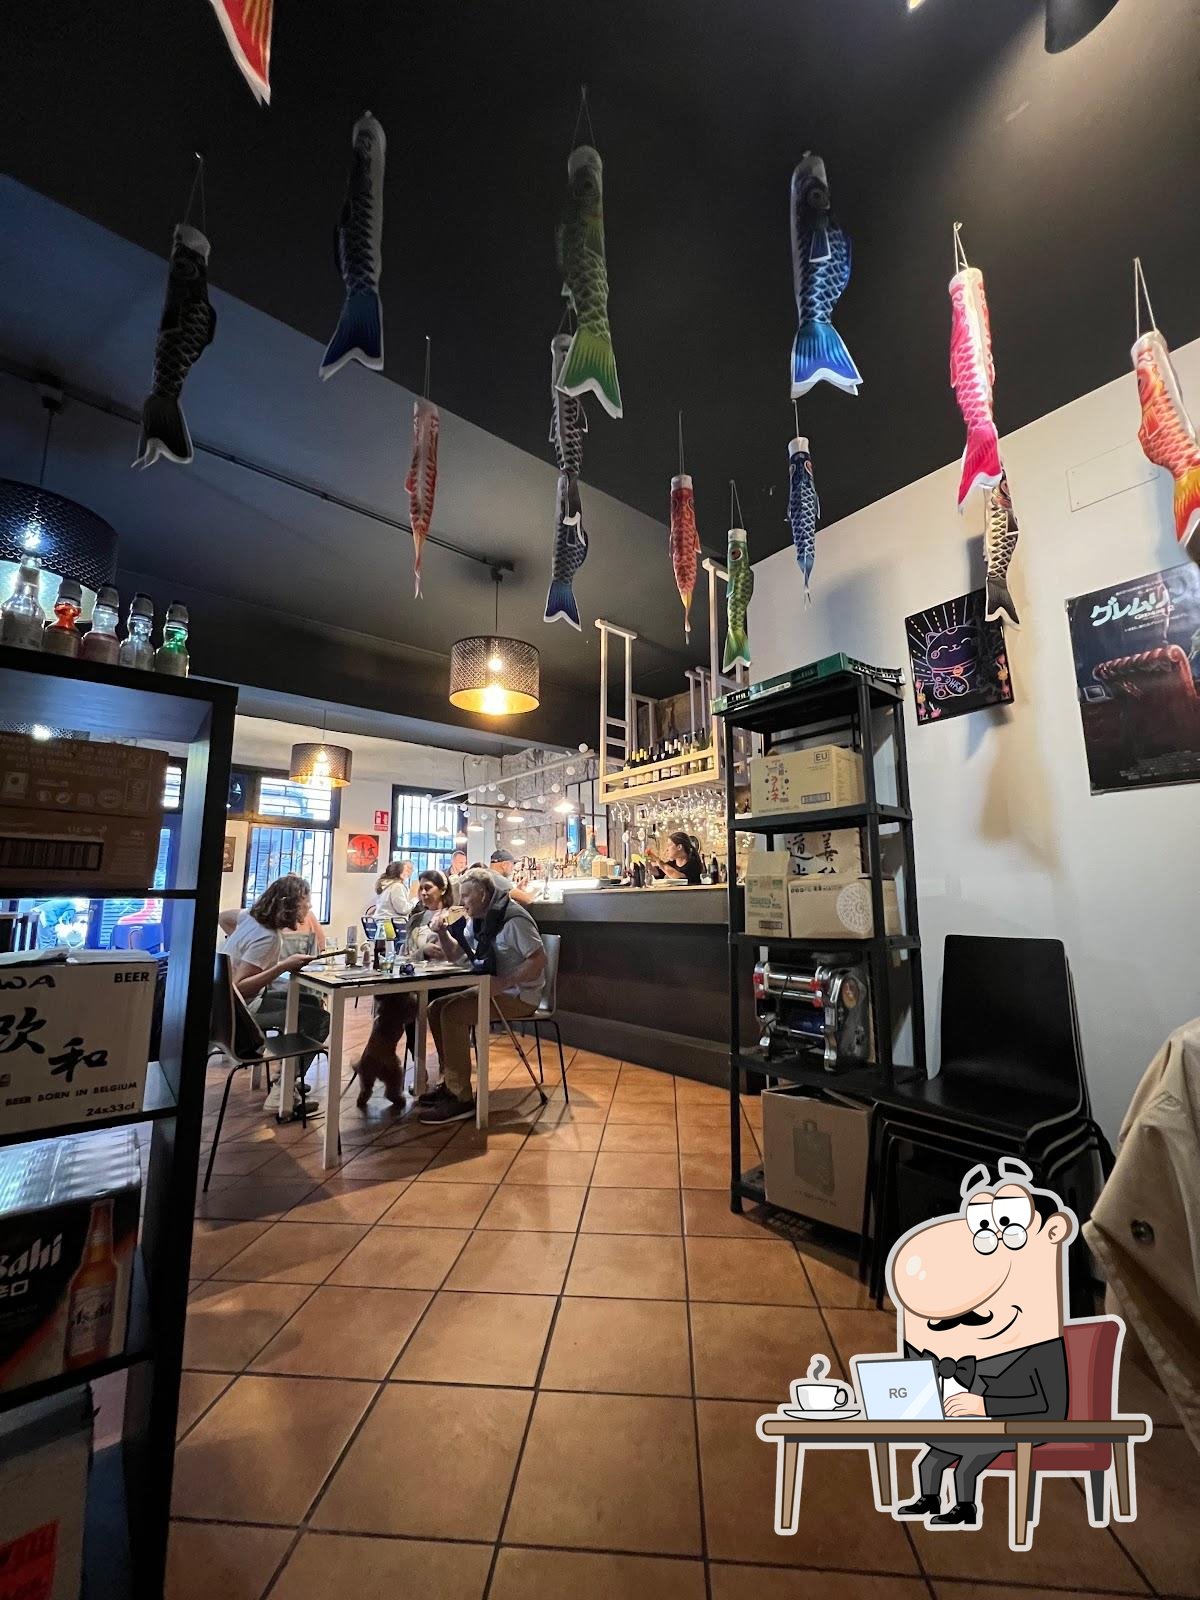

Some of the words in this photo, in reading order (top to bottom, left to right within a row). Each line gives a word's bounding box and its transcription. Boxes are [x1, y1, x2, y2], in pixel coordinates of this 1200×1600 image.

[815, 752, 828, 762] EU
[114, 972, 150, 983] BEER
[6, 1096, 32, 1107] BEER
[38, 1091, 70, 1102] BORN
[76, 1088, 88, 1097] IN
[93, 1081, 138, 1094] BELGIUM
